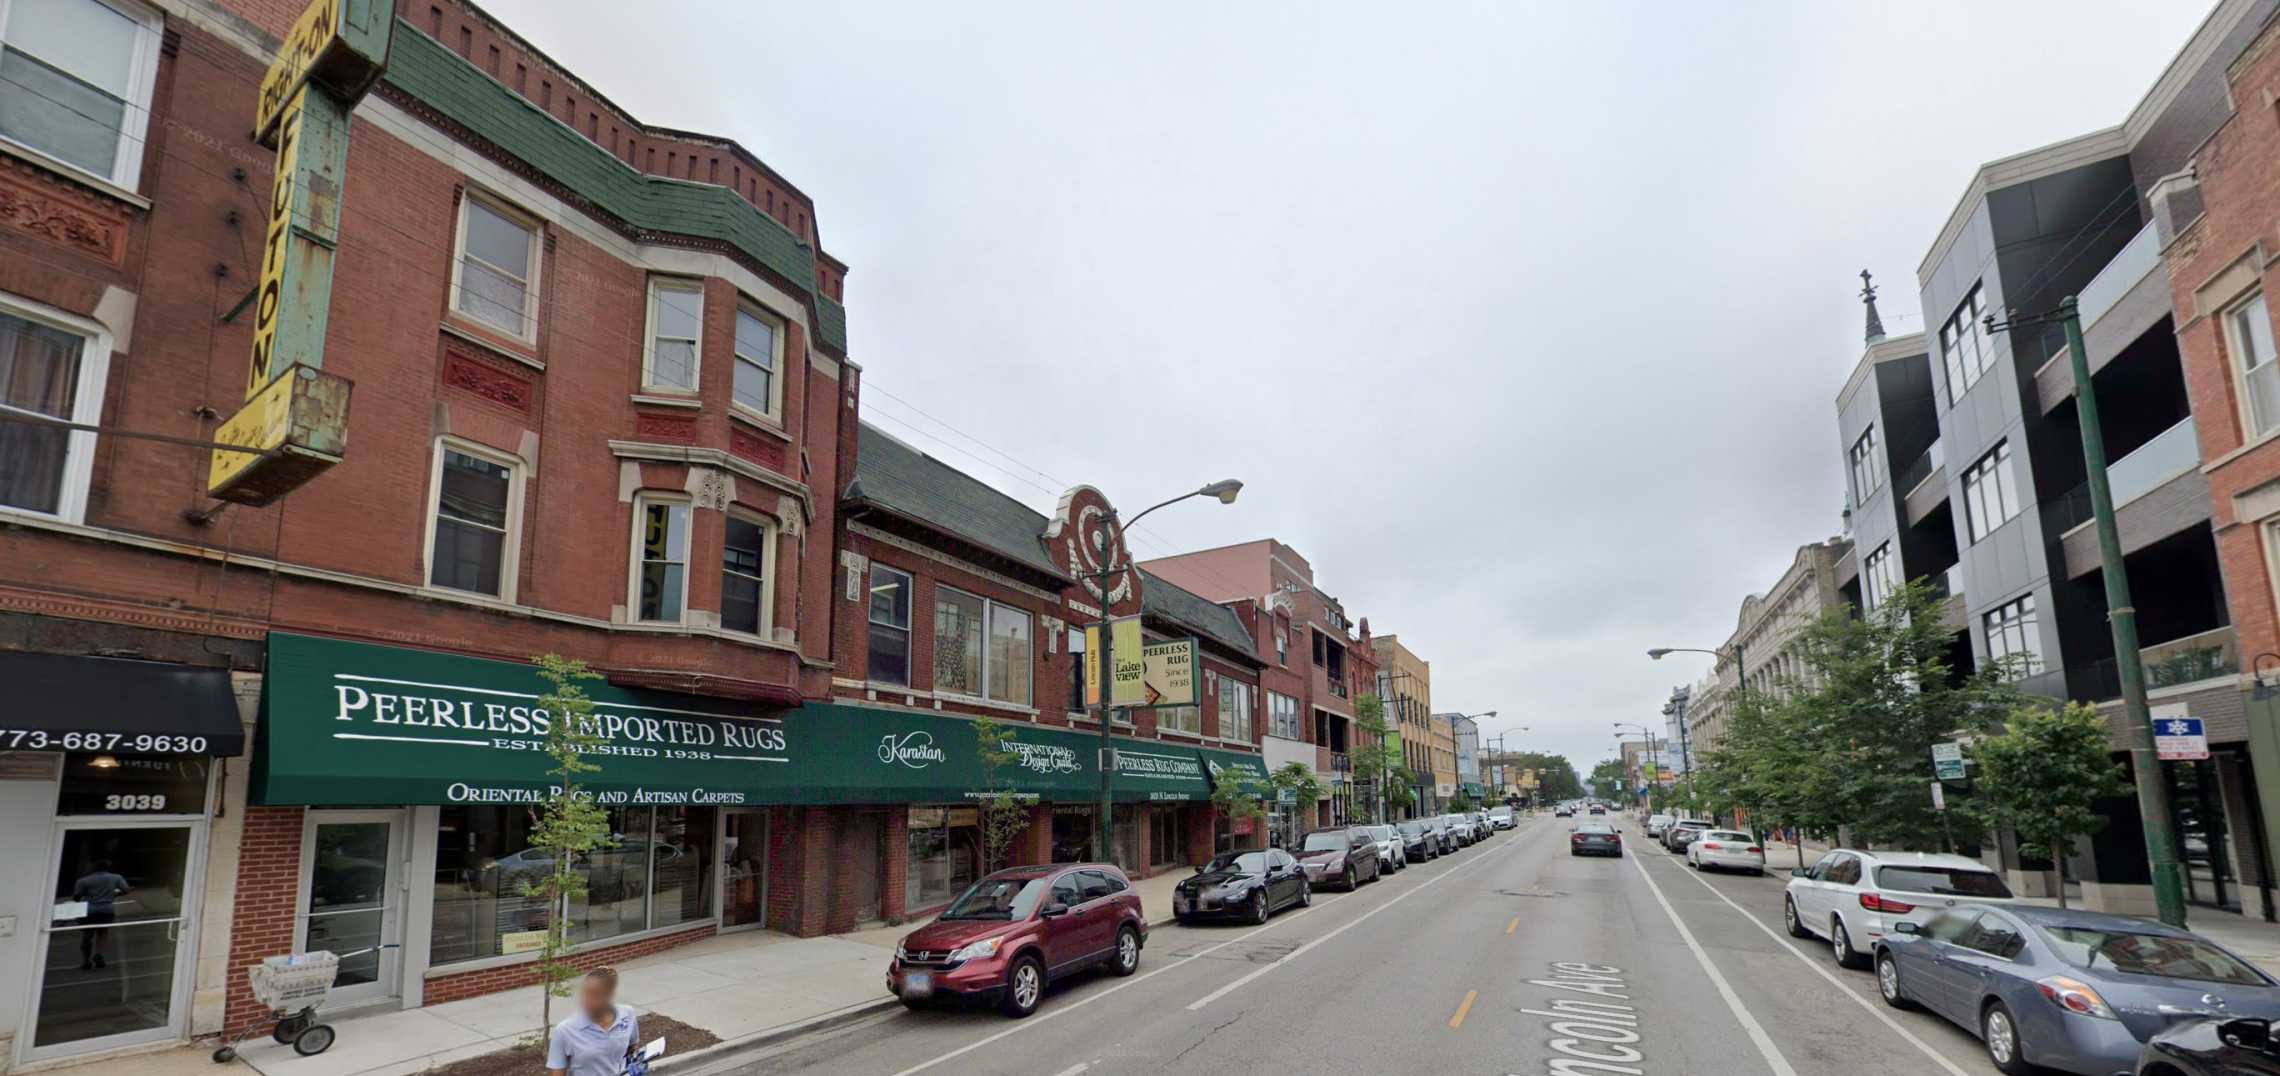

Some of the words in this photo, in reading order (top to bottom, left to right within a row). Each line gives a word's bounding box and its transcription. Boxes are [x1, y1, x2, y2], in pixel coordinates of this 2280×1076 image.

[250, 109, 300, 389] FUTON
[1143, 643, 1189, 657] PEERLESS
[1115, 661, 1141, 673] Lake
[1167, 655, 1189, 665] RUG
[1115, 671, 1141, 682] view
[1166, 667, 1189, 678] Since
[1169, 678, 1190, 689] 1938
[334, 684, 551, 735] PEERLESS
[562, 707, 715, 746] IMPORTED
[720, 721, 787, 751] RUGS
[663, 749, 712, 761] 1938
[878, 730, 945, 769] Karastan
[1119, 756, 1155, 772] PEERLESS
[1154, 758, 1170, 773] RUG
[1170, 760, 1200, 775] COMPANY
[447, 782, 542, 802] ORIENTAL
[550, 785, 592, 803] RGS
[597, 790, 628, 803] AND
[632, 787, 688, 803] ARTISAN
[692, 788, 745, 804] CARPETS
[105, 794, 166, 811] 3039
